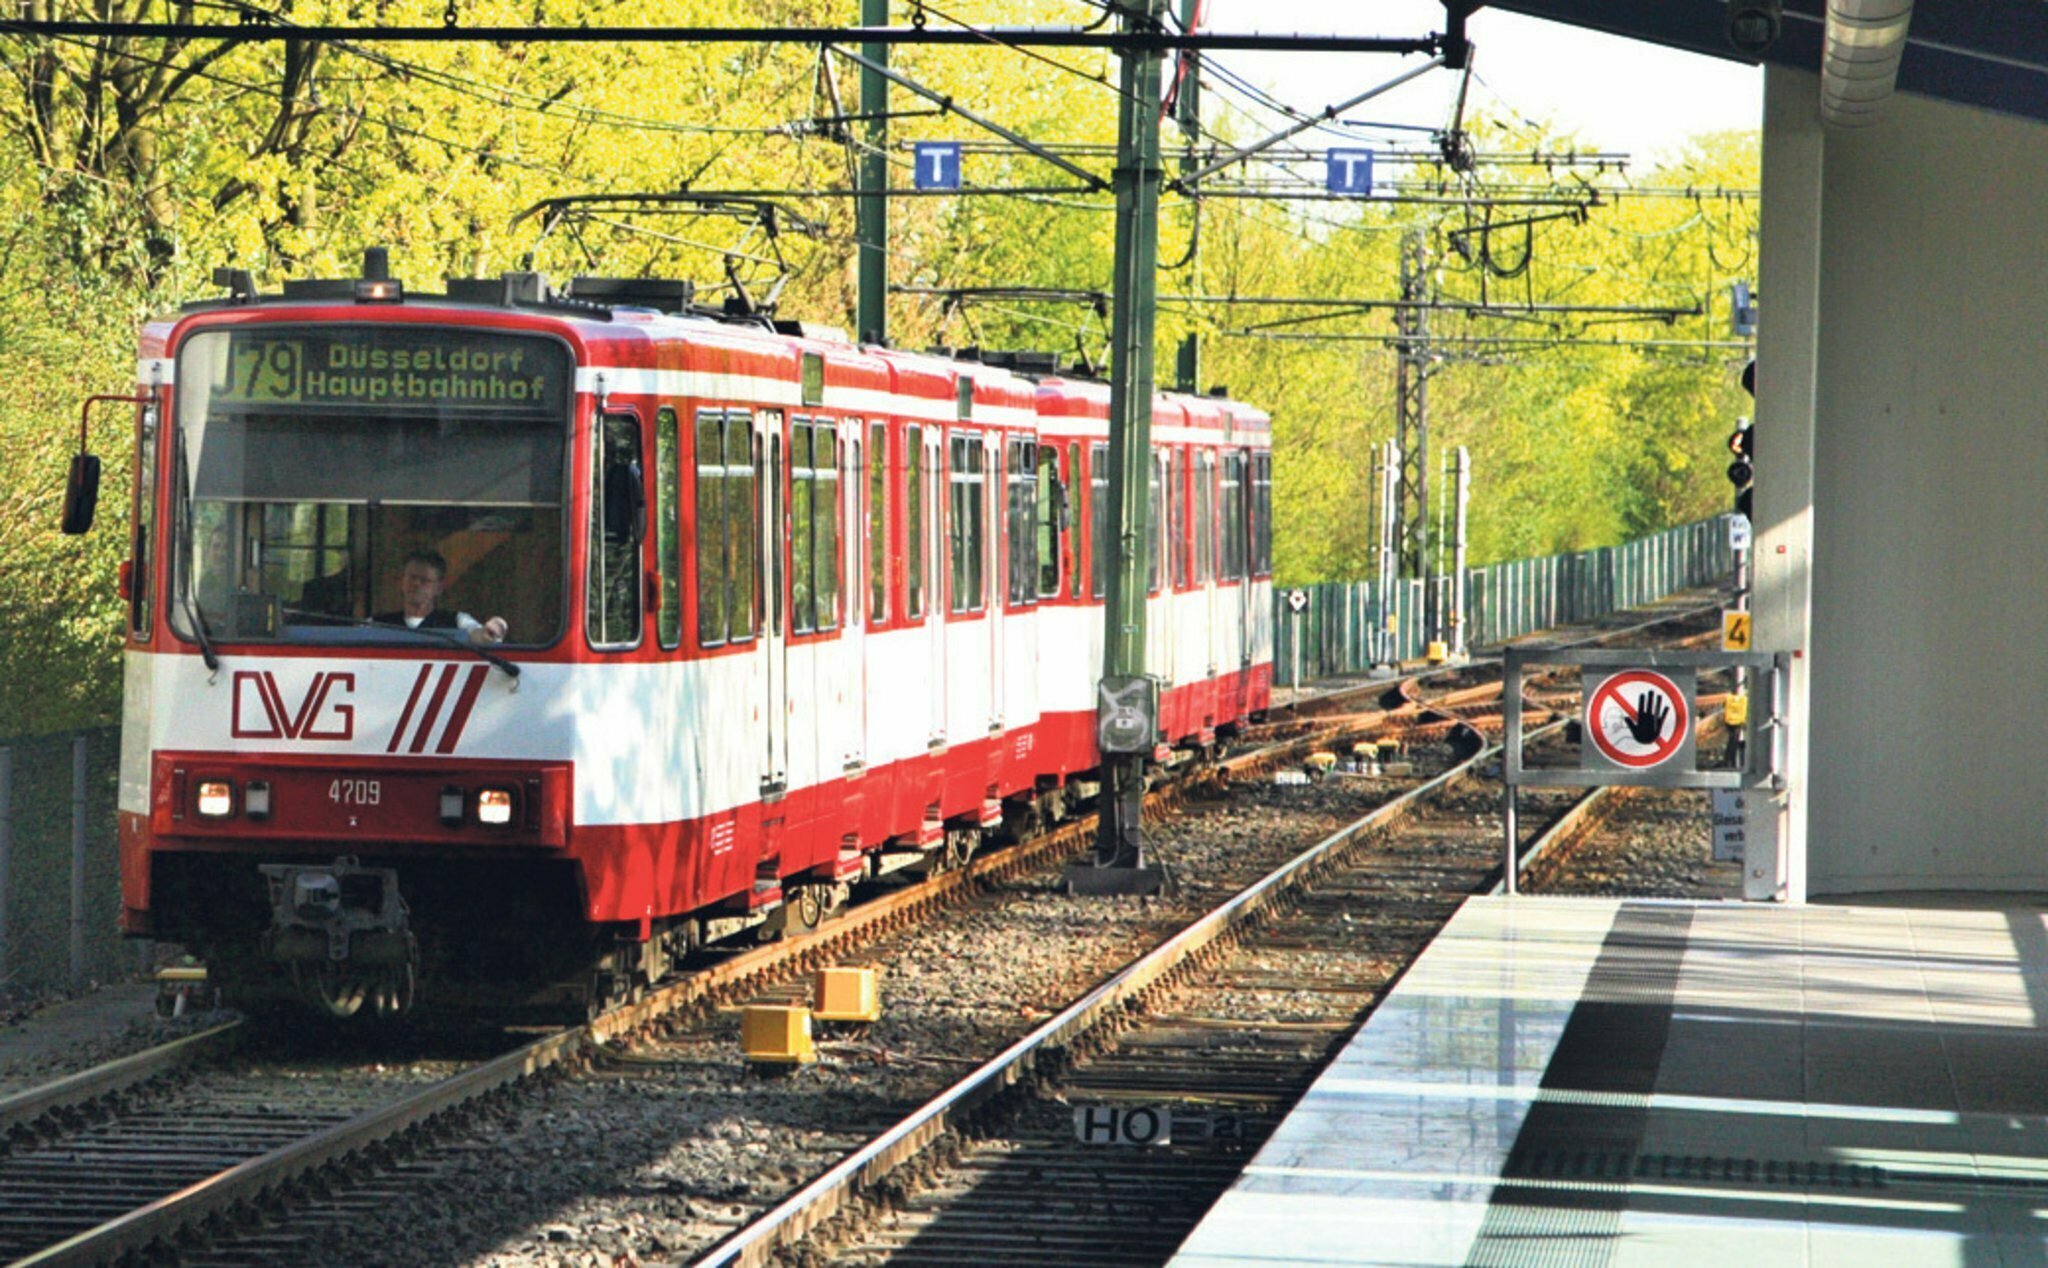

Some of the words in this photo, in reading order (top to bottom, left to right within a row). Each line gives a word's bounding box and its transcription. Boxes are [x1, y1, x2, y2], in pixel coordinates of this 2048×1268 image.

[921, 147, 954, 182] T
[1332, 153, 1368, 187] T
[328, 344, 524, 373] Düsseldorf
[306, 370, 545, 400] Hauptbahnhof
[1728, 618, 1746, 646] 4
[231, 670, 355, 741] DVG
[328, 778, 381, 806] 4709
[1084, 1106, 1160, 1143] HO
